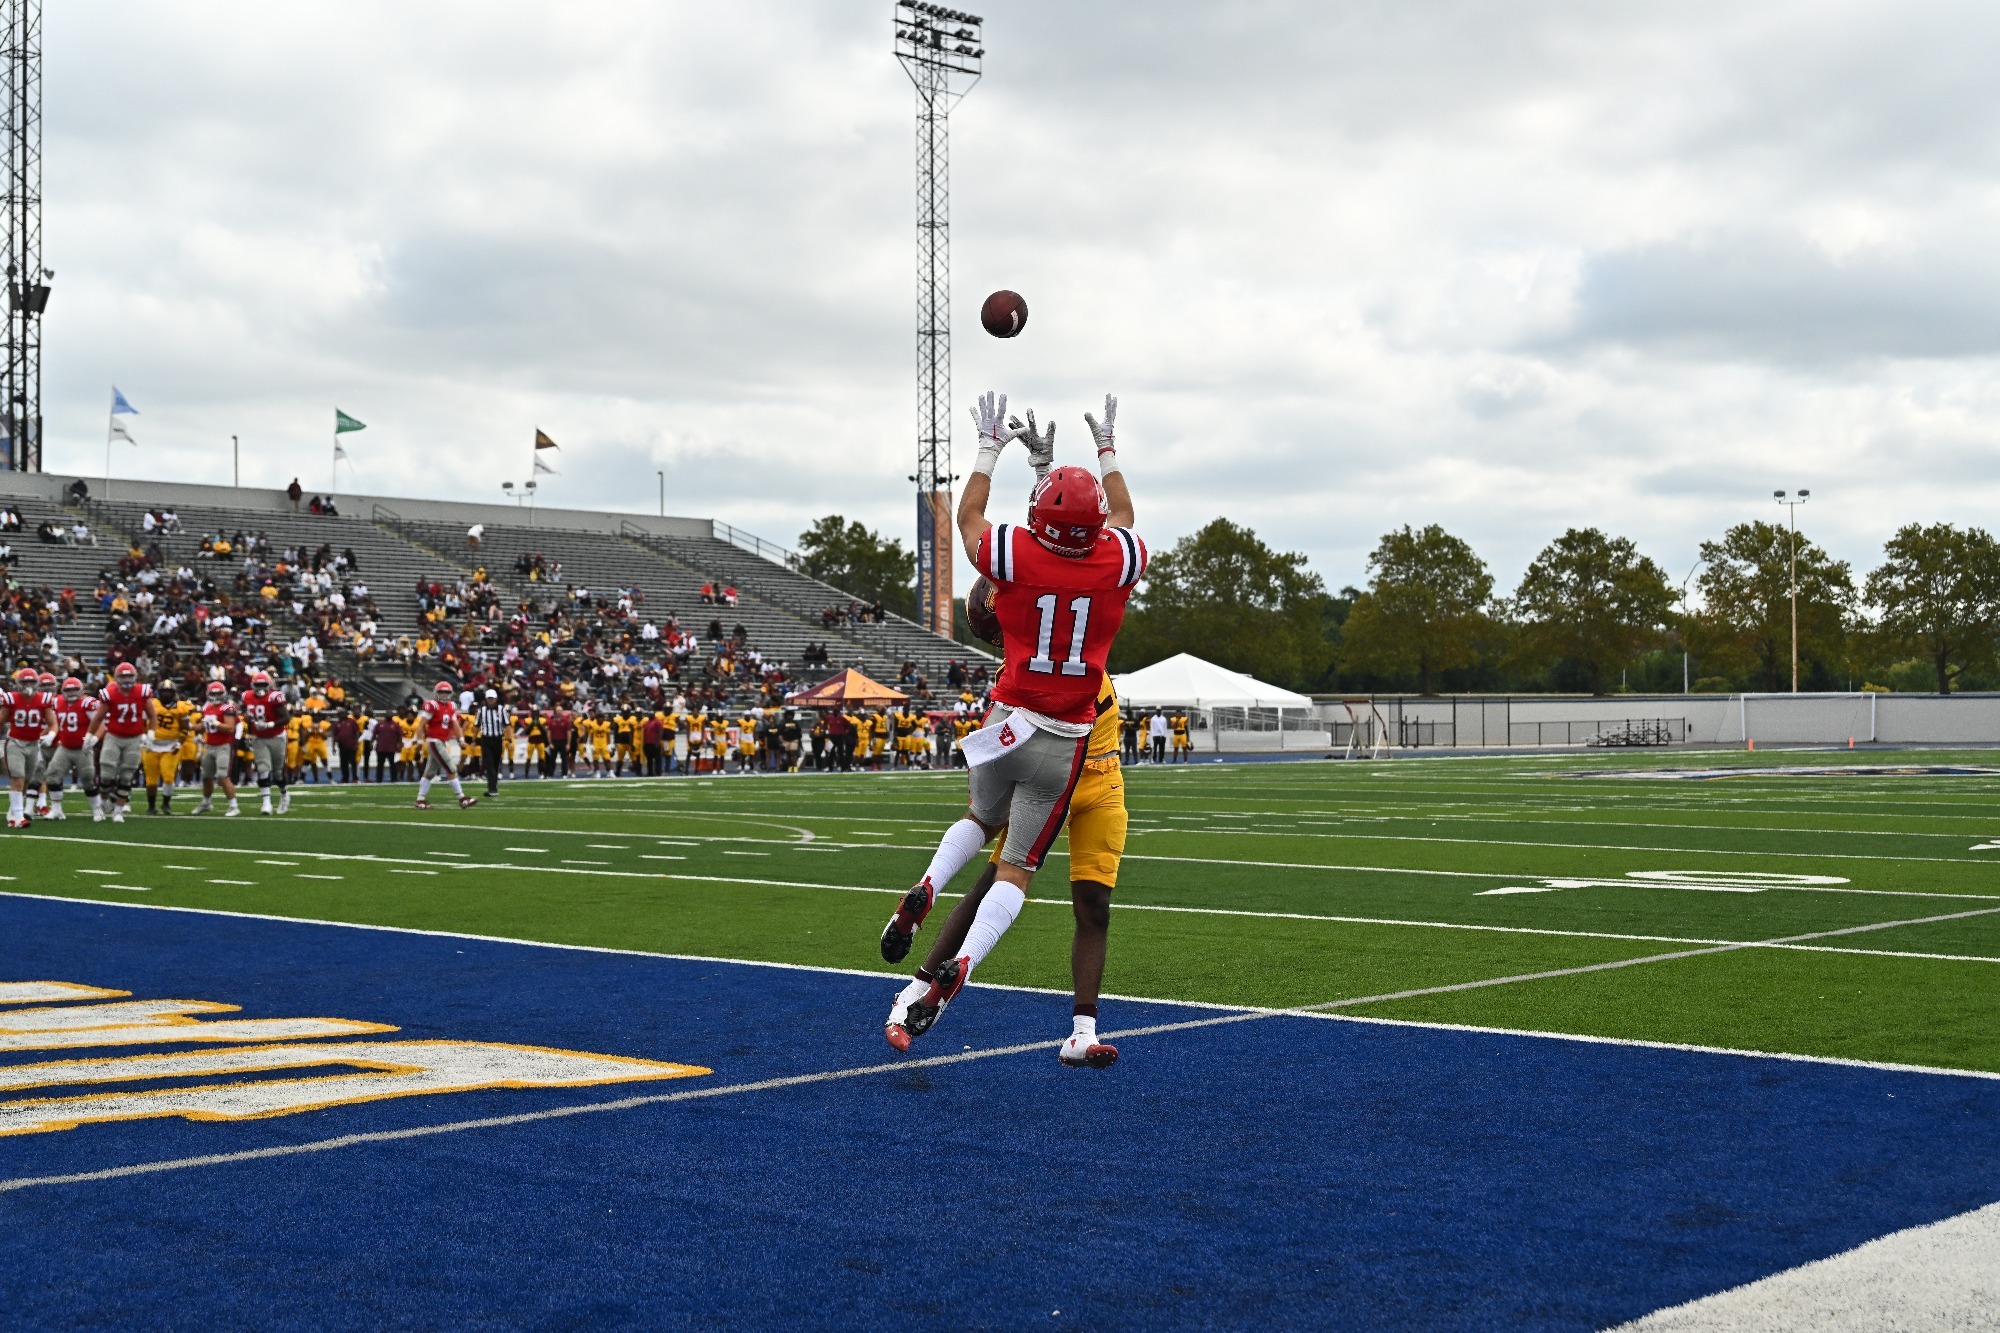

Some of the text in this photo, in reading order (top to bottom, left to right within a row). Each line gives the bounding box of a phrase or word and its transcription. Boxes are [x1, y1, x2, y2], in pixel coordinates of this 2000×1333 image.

[1028, 593, 1092, 677] 11
[57, 712, 79, 732] 79
[117, 703, 138, 723] 71
